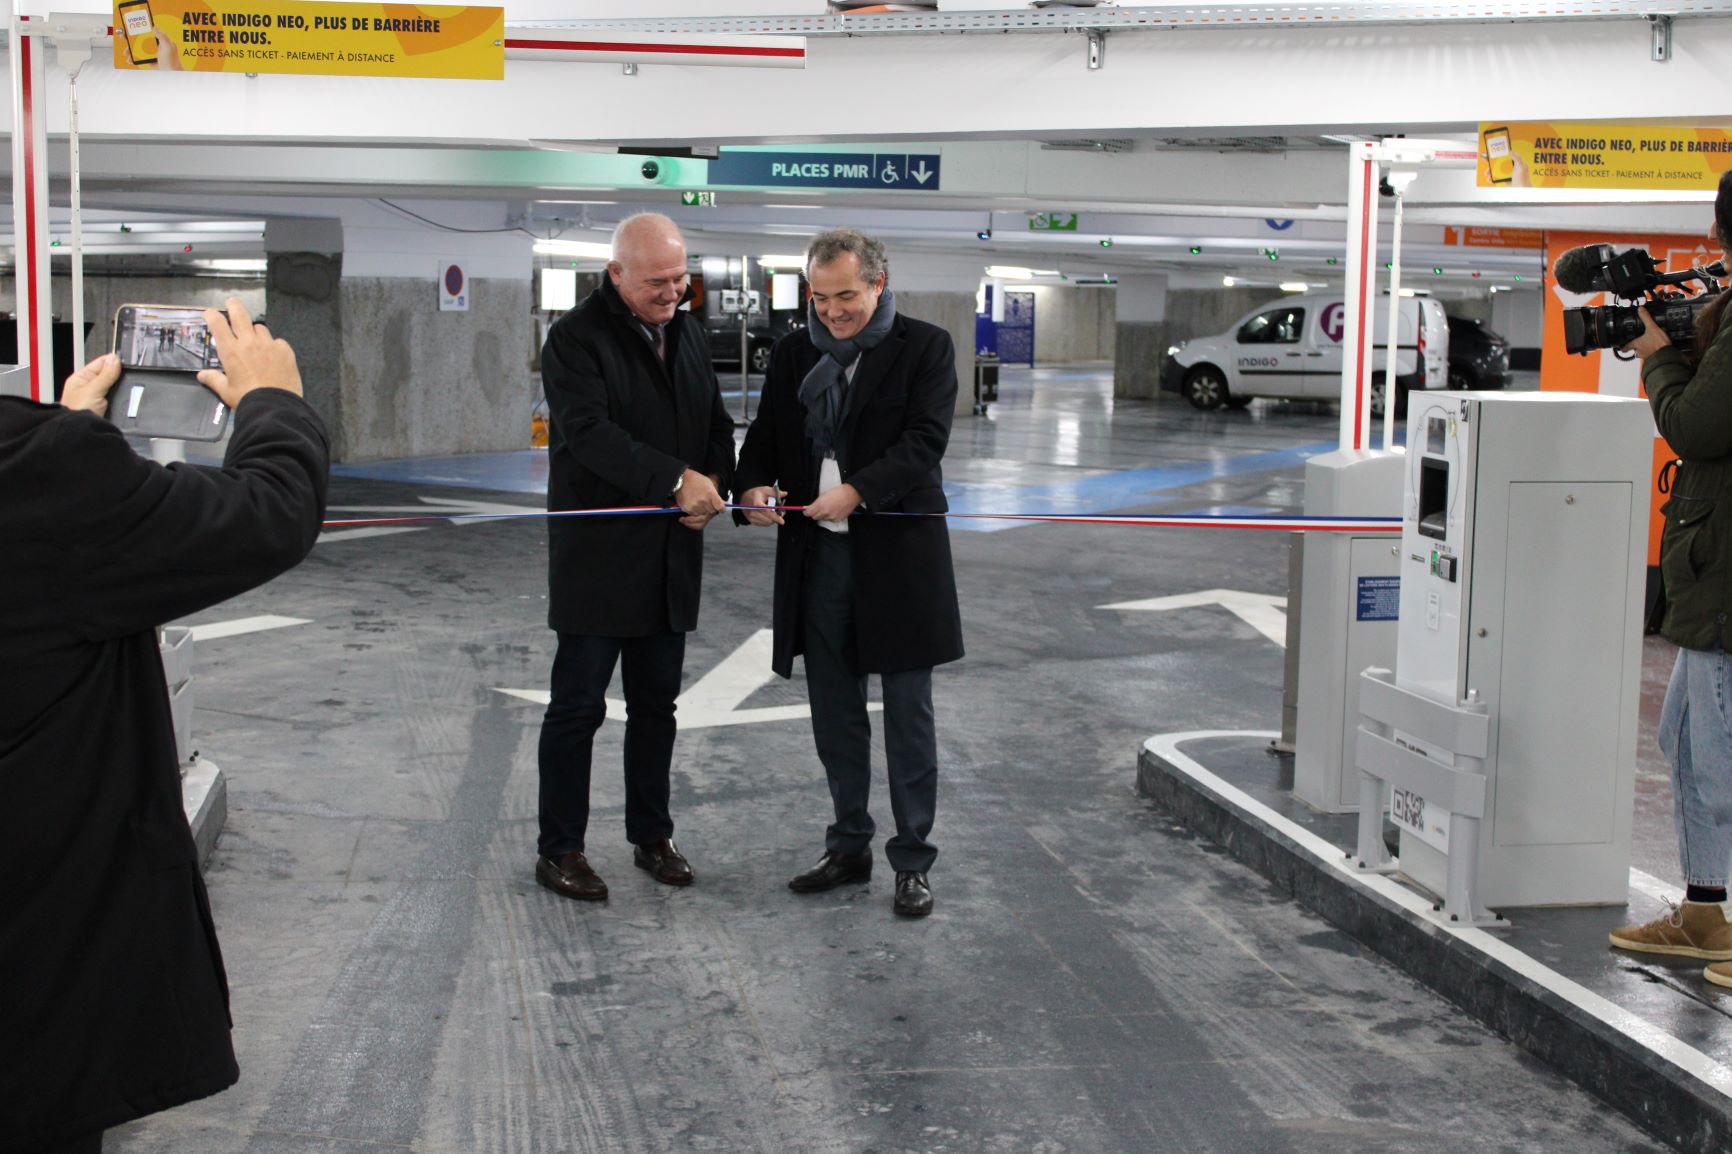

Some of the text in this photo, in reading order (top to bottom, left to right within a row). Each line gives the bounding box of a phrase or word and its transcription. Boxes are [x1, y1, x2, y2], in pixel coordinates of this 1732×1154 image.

[182, 11, 441, 34] AVEC INDIGO NEO, PLUS DE BARRIÈRE
[182, 29, 273, 46] ENTRE NOUS.
[182, 46, 215, 59] ACCÈS
[218, 49, 247, 60] SANS
[248, 50, 280, 61] TICKET
[286, 51, 335, 63] PAIEMENT
[337, 50, 346, 64] À
[347, 53, 396, 64] DISTANCE
[1534, 137, 1563, 150] AVEC
[1566, 138, 1607, 151] INDIGO
[1610, 139, 1636, 154] NEO,
[1640, 140, 1667, 153] PLUS
[1670, 141, 1685, 153] DE
[1533, 152, 1605, 166] ENTRE NOUS.
[771, 162, 869, 179] PLACES PMR
[1561, 169, 1583, 178] SANS
[1585, 170, 1611, 178] TICKET
[1616, 170, 1655, 180] PAIEMENT
[1656, 169, 1663, 180] À
[1664, 171, 1703, 180] DISTANCE
[1237, 357, 1279, 368] INDIGO
